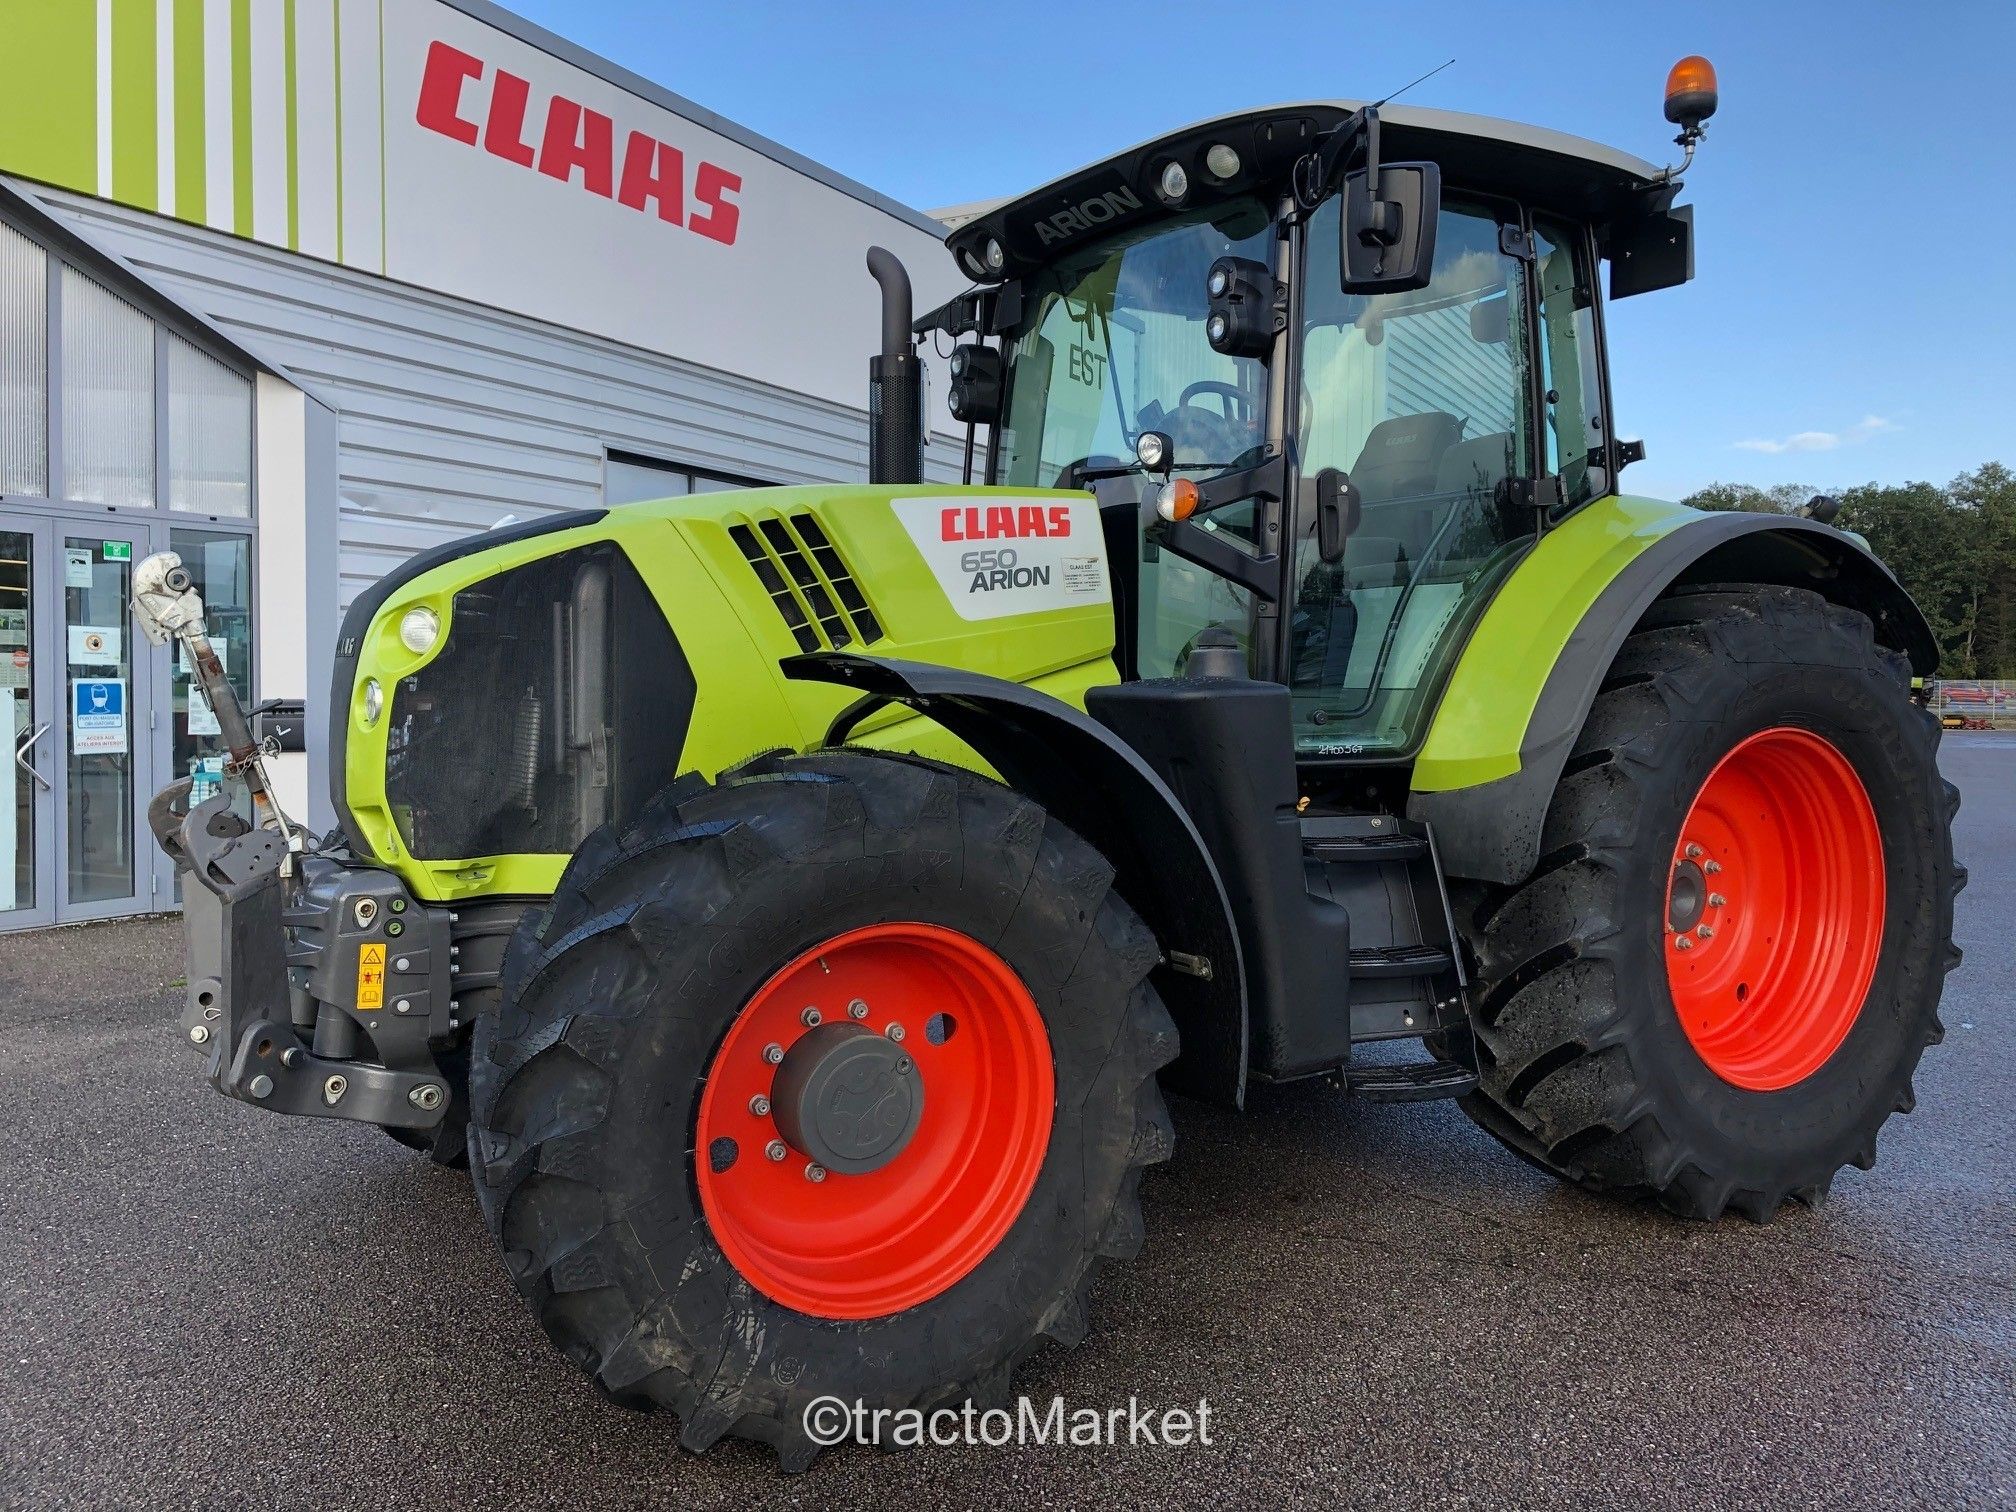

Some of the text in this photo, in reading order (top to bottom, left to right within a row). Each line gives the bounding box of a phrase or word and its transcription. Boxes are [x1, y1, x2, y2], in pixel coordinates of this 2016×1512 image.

[416, 40, 743, 246] CLAAS
[1034, 185, 1144, 246] ARION
[1069, 343, 1107, 390] EST
[941, 506, 1071, 542] CLAAS
[960, 548, 1018, 573] 650
[969, 565, 1050, 594] ARION
